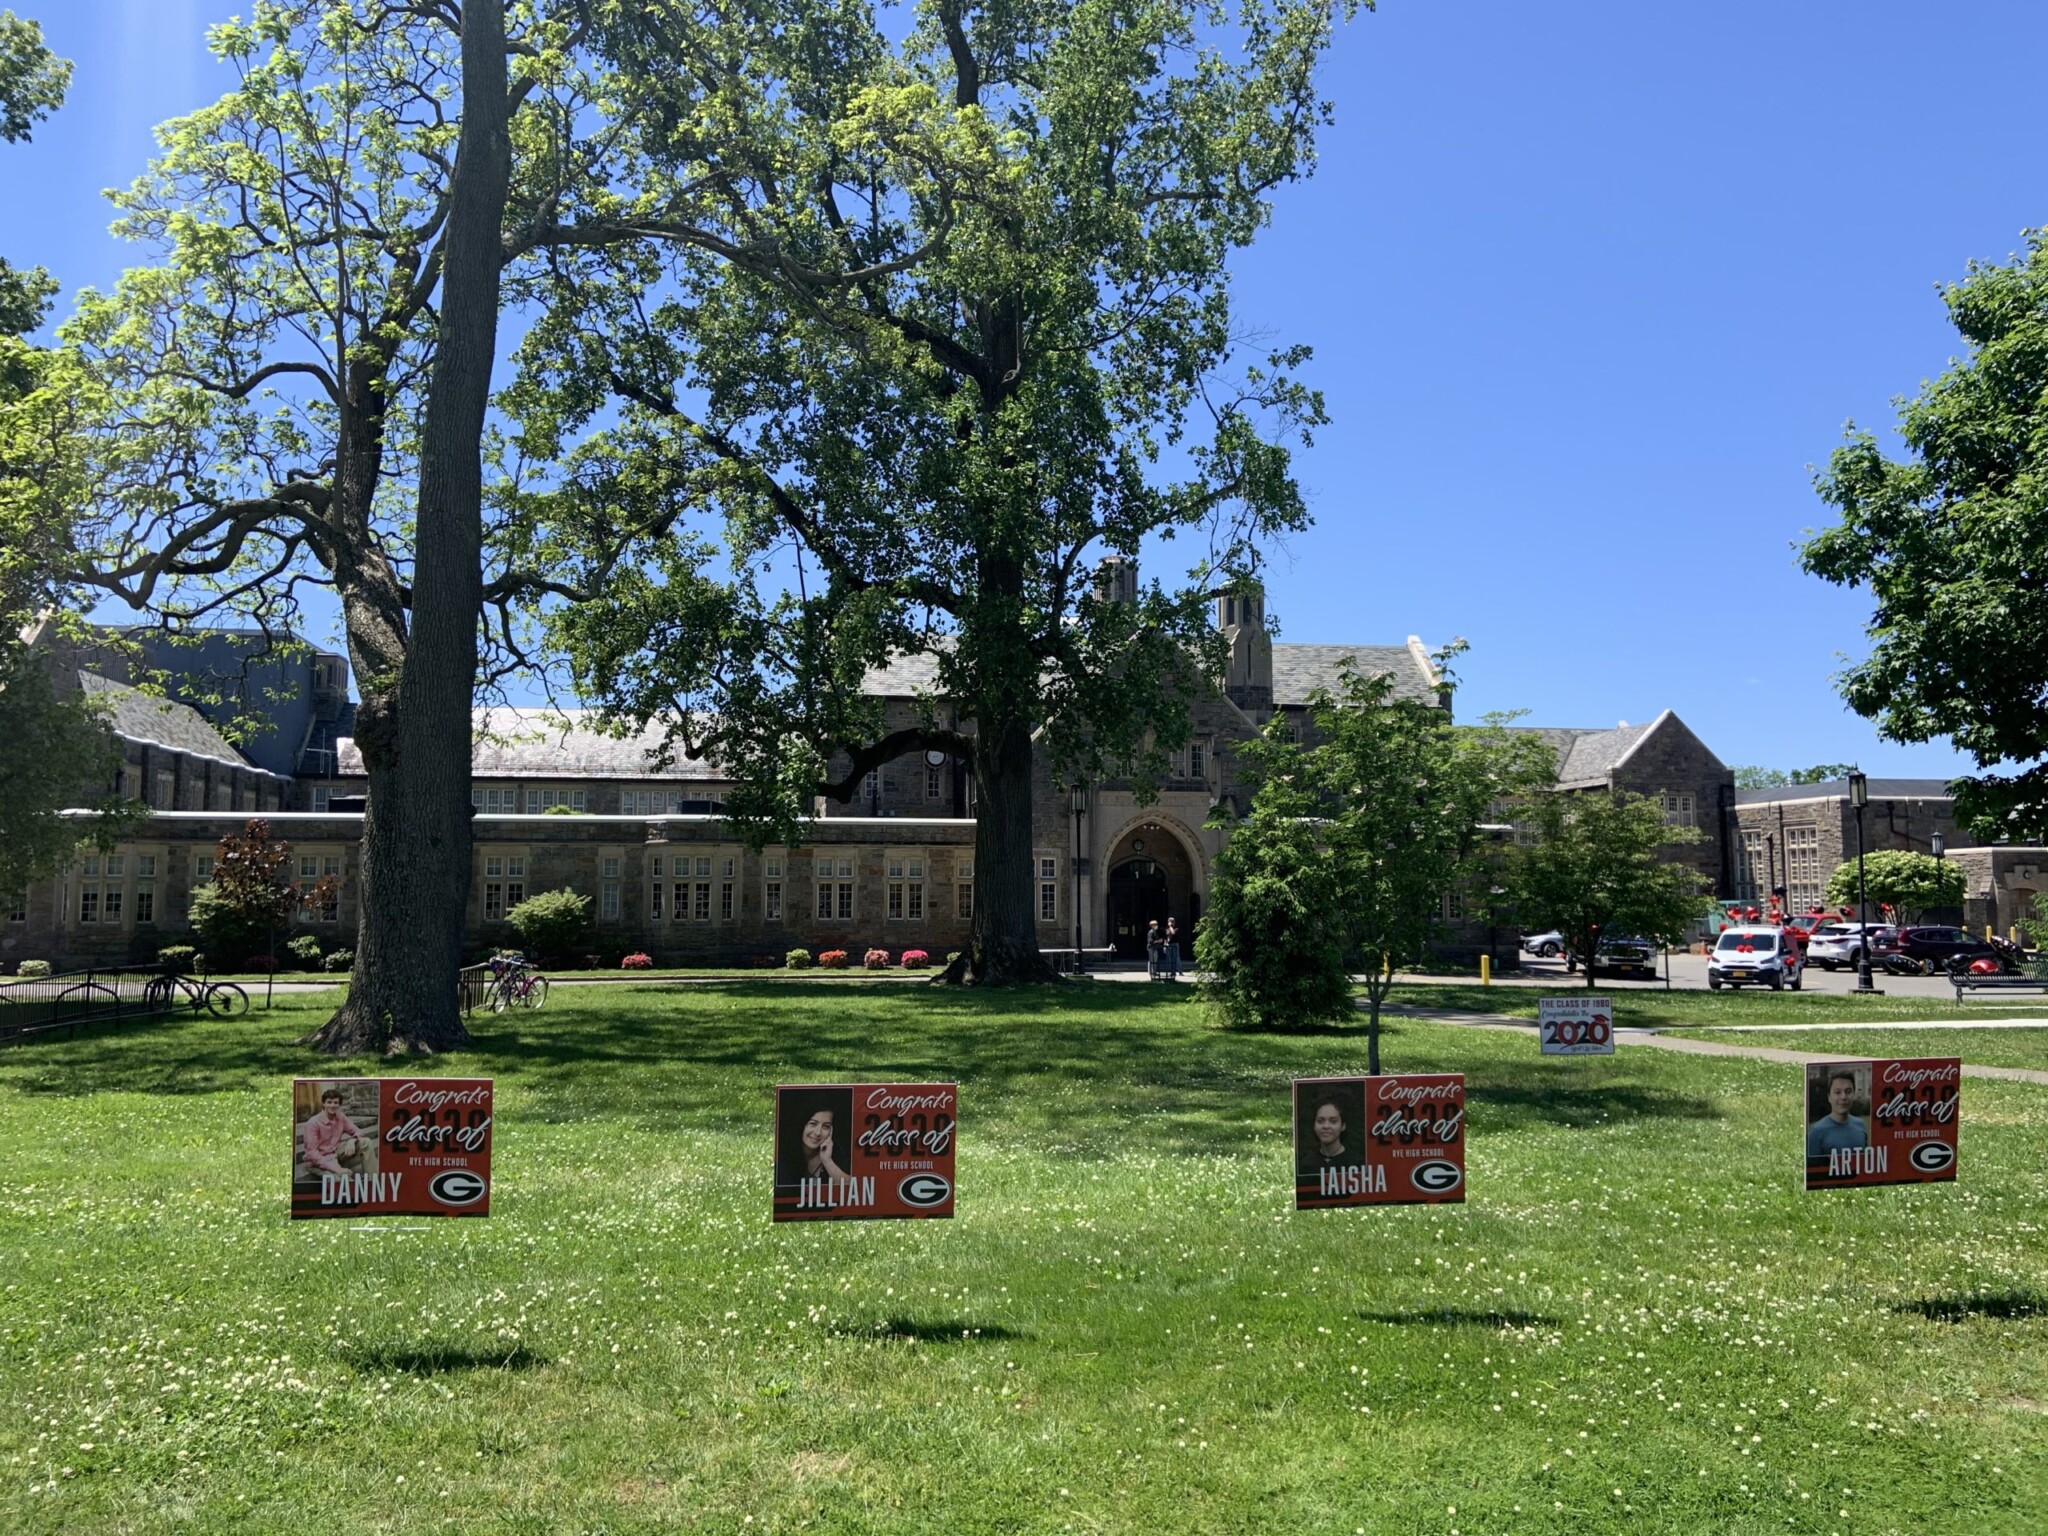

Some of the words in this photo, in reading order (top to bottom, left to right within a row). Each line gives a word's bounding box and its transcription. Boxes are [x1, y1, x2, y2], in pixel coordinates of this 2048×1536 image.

[1542, 1000, 1554, 1008] THE
[1557, 1000, 1579, 1008] CLASS
[1544, 1021, 1609, 1044] 2020
[1883, 1062, 1958, 1089] Congrats
[394, 1082, 489, 1112] Congrats
[866, 1088, 953, 1117] Congrats
[1378, 1080, 1461, 1108] Congrats
[1876, 1093, 1927, 1118] class
[1931, 1091, 1959, 1123] of
[386, 1115, 451, 1142] class
[456, 1117, 491, 1151] of
[859, 1120, 918, 1147] class
[923, 1120, 955, 1154] of
[1372, 1110, 1428, 1136] class
[1433, 1109, 1463, 1142] of
[1894, 1131, 1904, 1139] RYE
[1906, 1130, 1918, 1138] HIGH
[1920, 1129, 1940, 1138] SCHOOL
[409, 1157, 422, 1166] RYE
[424, 1157, 440, 1166] HIGH
[443, 1157, 468, 1166] SCHOOL
[880, 1161, 892, 1169] RYE
[893, 1161, 908, 1169] HIGH
[911, 1161, 933, 1170] SCHOOL
[1392, 1149, 1403, 1158] RYE
[1406, 1149, 1420, 1157] HIGH
[1422, 1148, 1444, 1157] SCHOOL
[1829, 1145, 1887, 1176] ARTON
[1910, 1141, 1954, 1172] G
[321, 1172, 402, 1204] DANNY
[431, 1171, 485, 1205] G
[898, 1173, 950, 1206] G
[1321, 1164, 1387, 1196] IAISHA
[1412, 1160, 1461, 1192] G
[797, 1176, 875, 1208] JILLIAN
